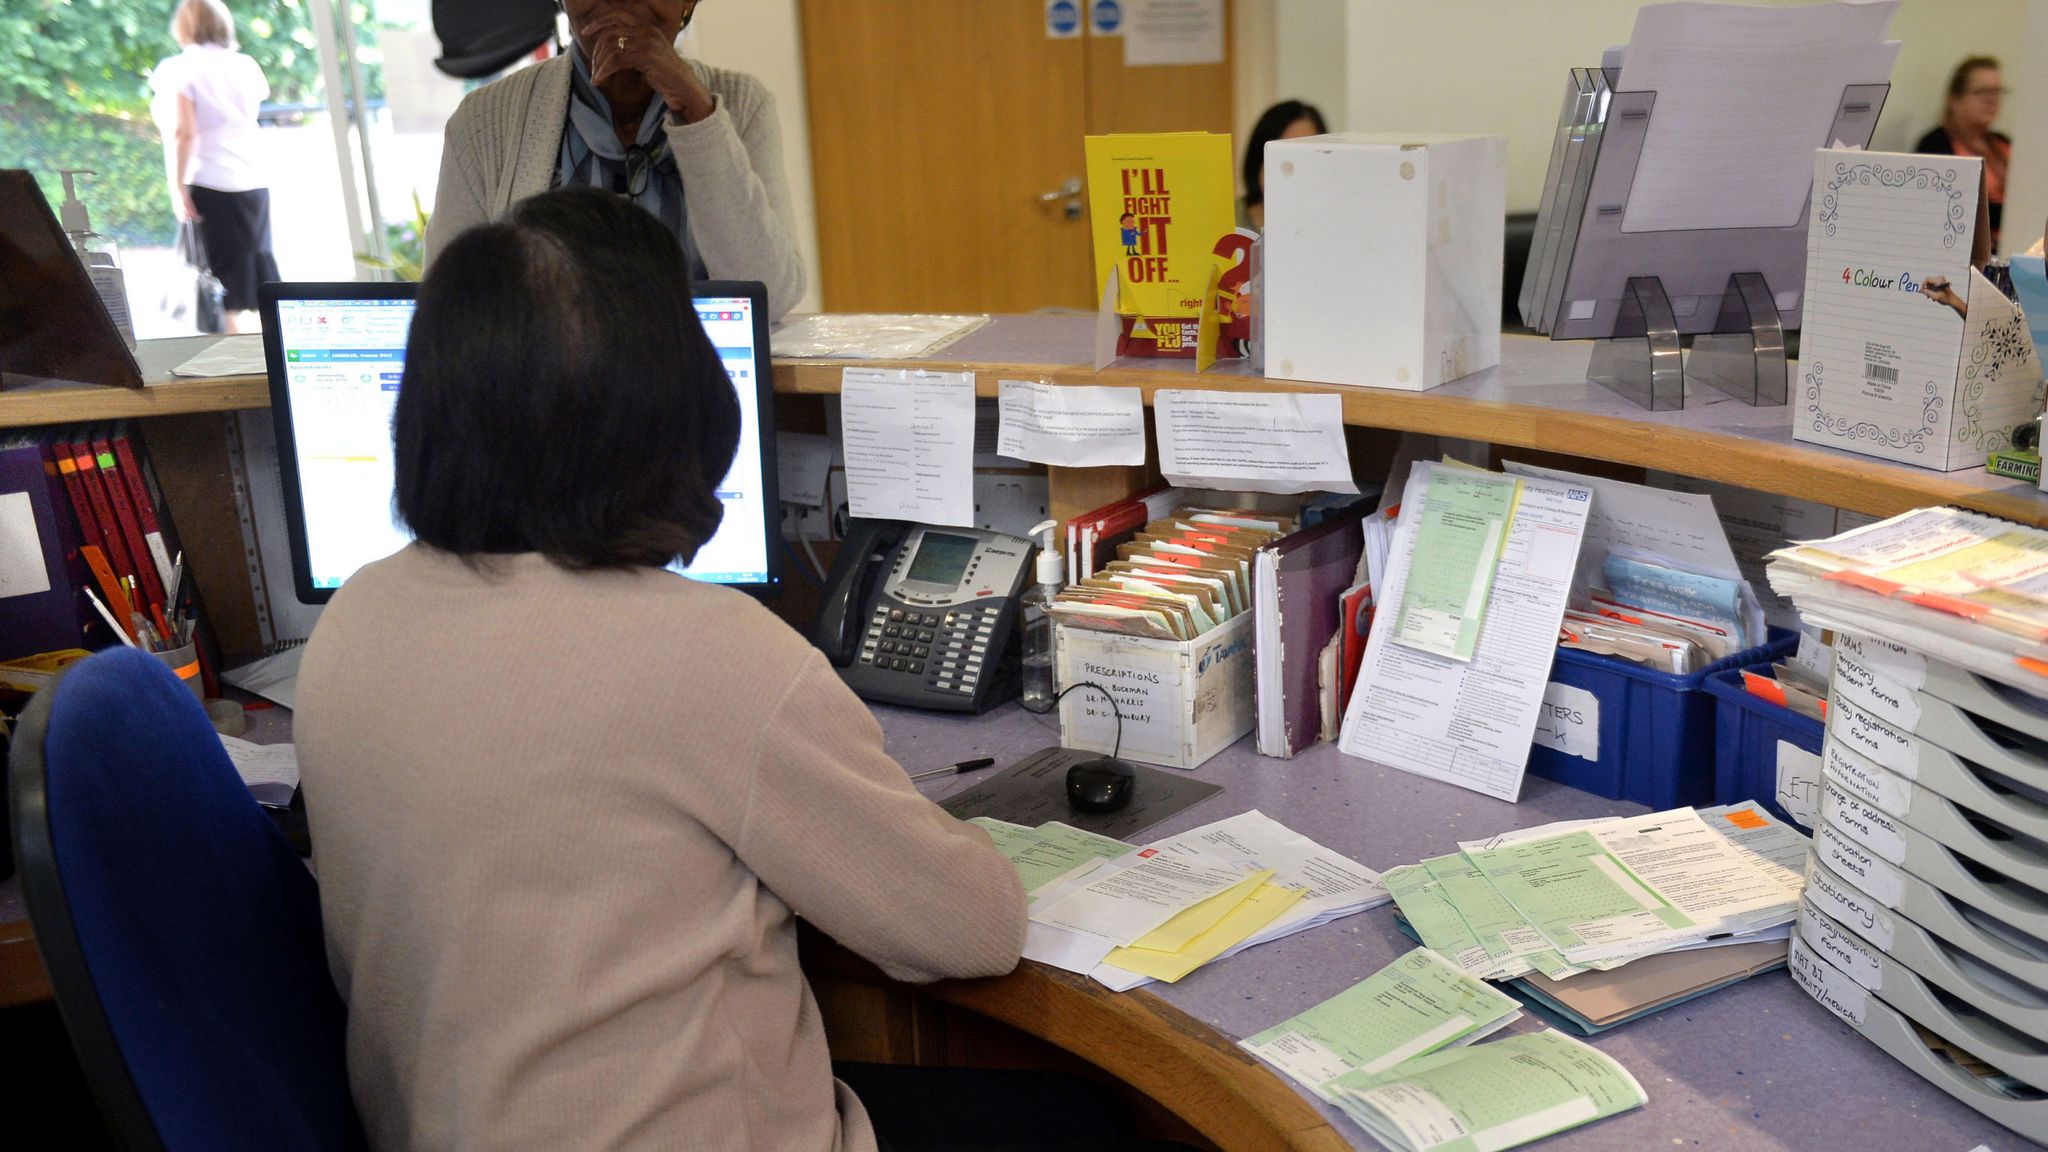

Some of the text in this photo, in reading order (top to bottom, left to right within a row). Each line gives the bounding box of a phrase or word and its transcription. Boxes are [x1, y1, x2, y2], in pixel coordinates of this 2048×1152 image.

[1124, 197, 1171, 215] FIGHT
[1139, 216, 1171, 256] IT
[1842, 267, 1851, 284] 4
[1854, 268, 1894, 289] Colour
[1154, 323, 1180, 336] YOU
[1157, 335, 1181, 348] FLU
[1996, 460, 2038, 477] FARMING
[1567, 489, 1588, 501] NHS
[1085, 663, 1159, 684] PRESCRIPTIONS
[1112, 684, 1149, 696] BUCKMAN
[1114, 697, 1144, 707] HARRIS
[1541, 701, 1584, 725] TERS
[1555, 725, 1567, 745] K
[1855, 712, 1909, 748] registration
[1850, 801, 1860, 811] of
[1862, 808, 1897, 834] address
[1819, 823, 1872, 868] Continuation
[1812, 871, 1875, 930] Stationery
